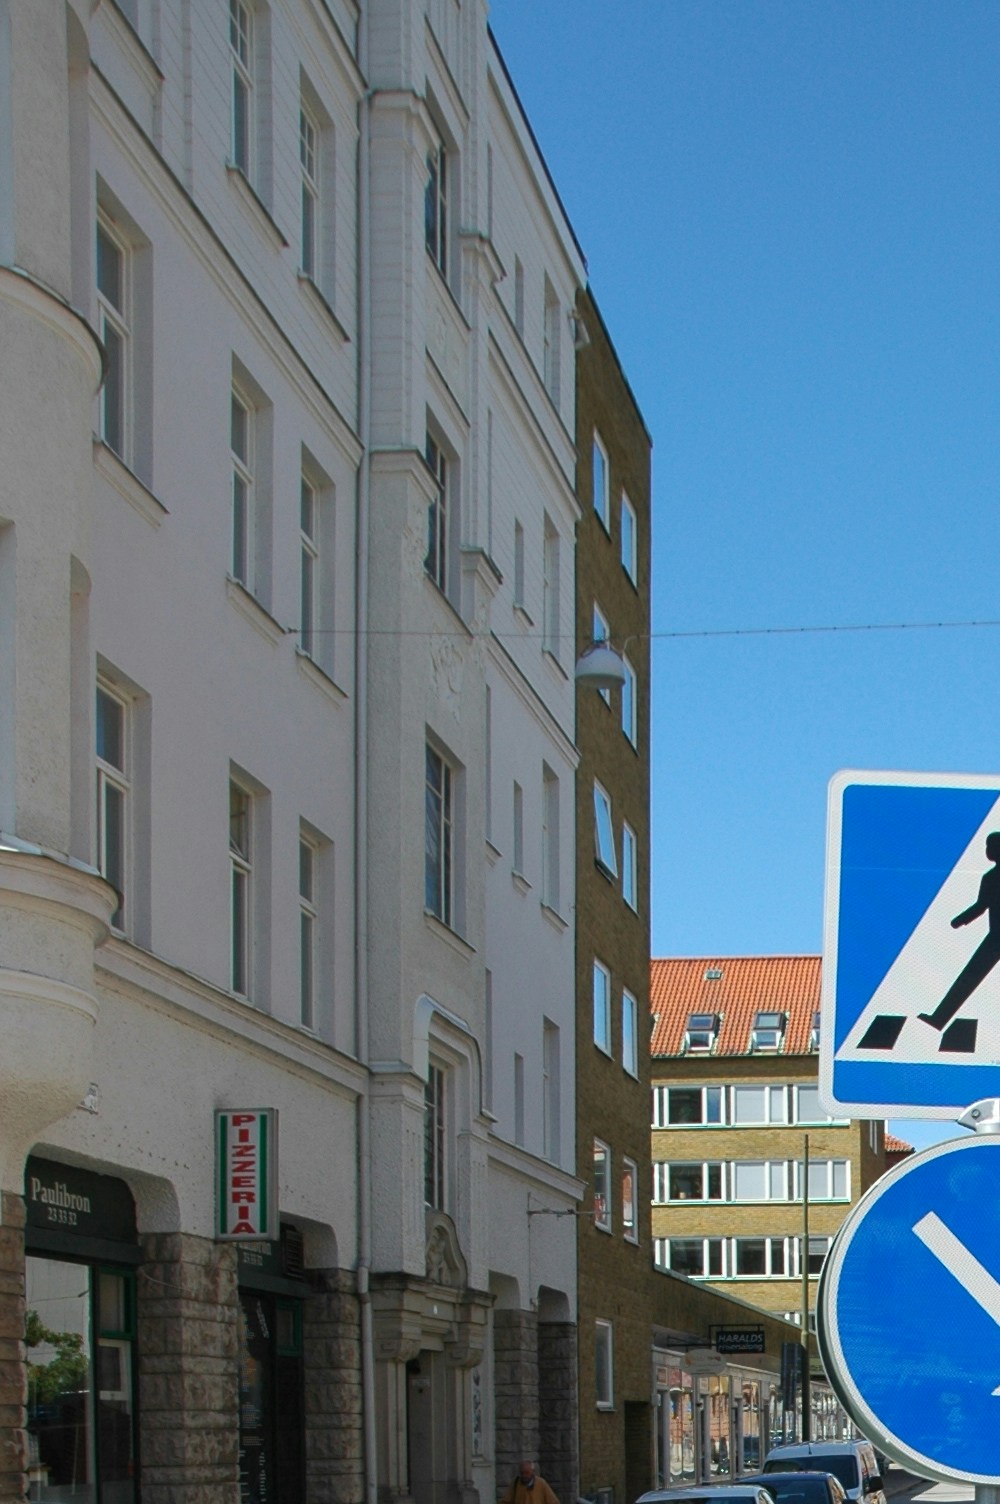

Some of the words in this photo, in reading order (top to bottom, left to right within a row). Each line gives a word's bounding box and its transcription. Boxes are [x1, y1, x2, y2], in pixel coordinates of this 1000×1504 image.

[231, 1114, 257, 1234] PIZZERIA
[31, 1176, 91, 1213] Paulibron
[47, 1207, 57, 1221] 23
[58, 1209, 67, 1224] 33
[718, 1333, 763, 1343] HARALDS
